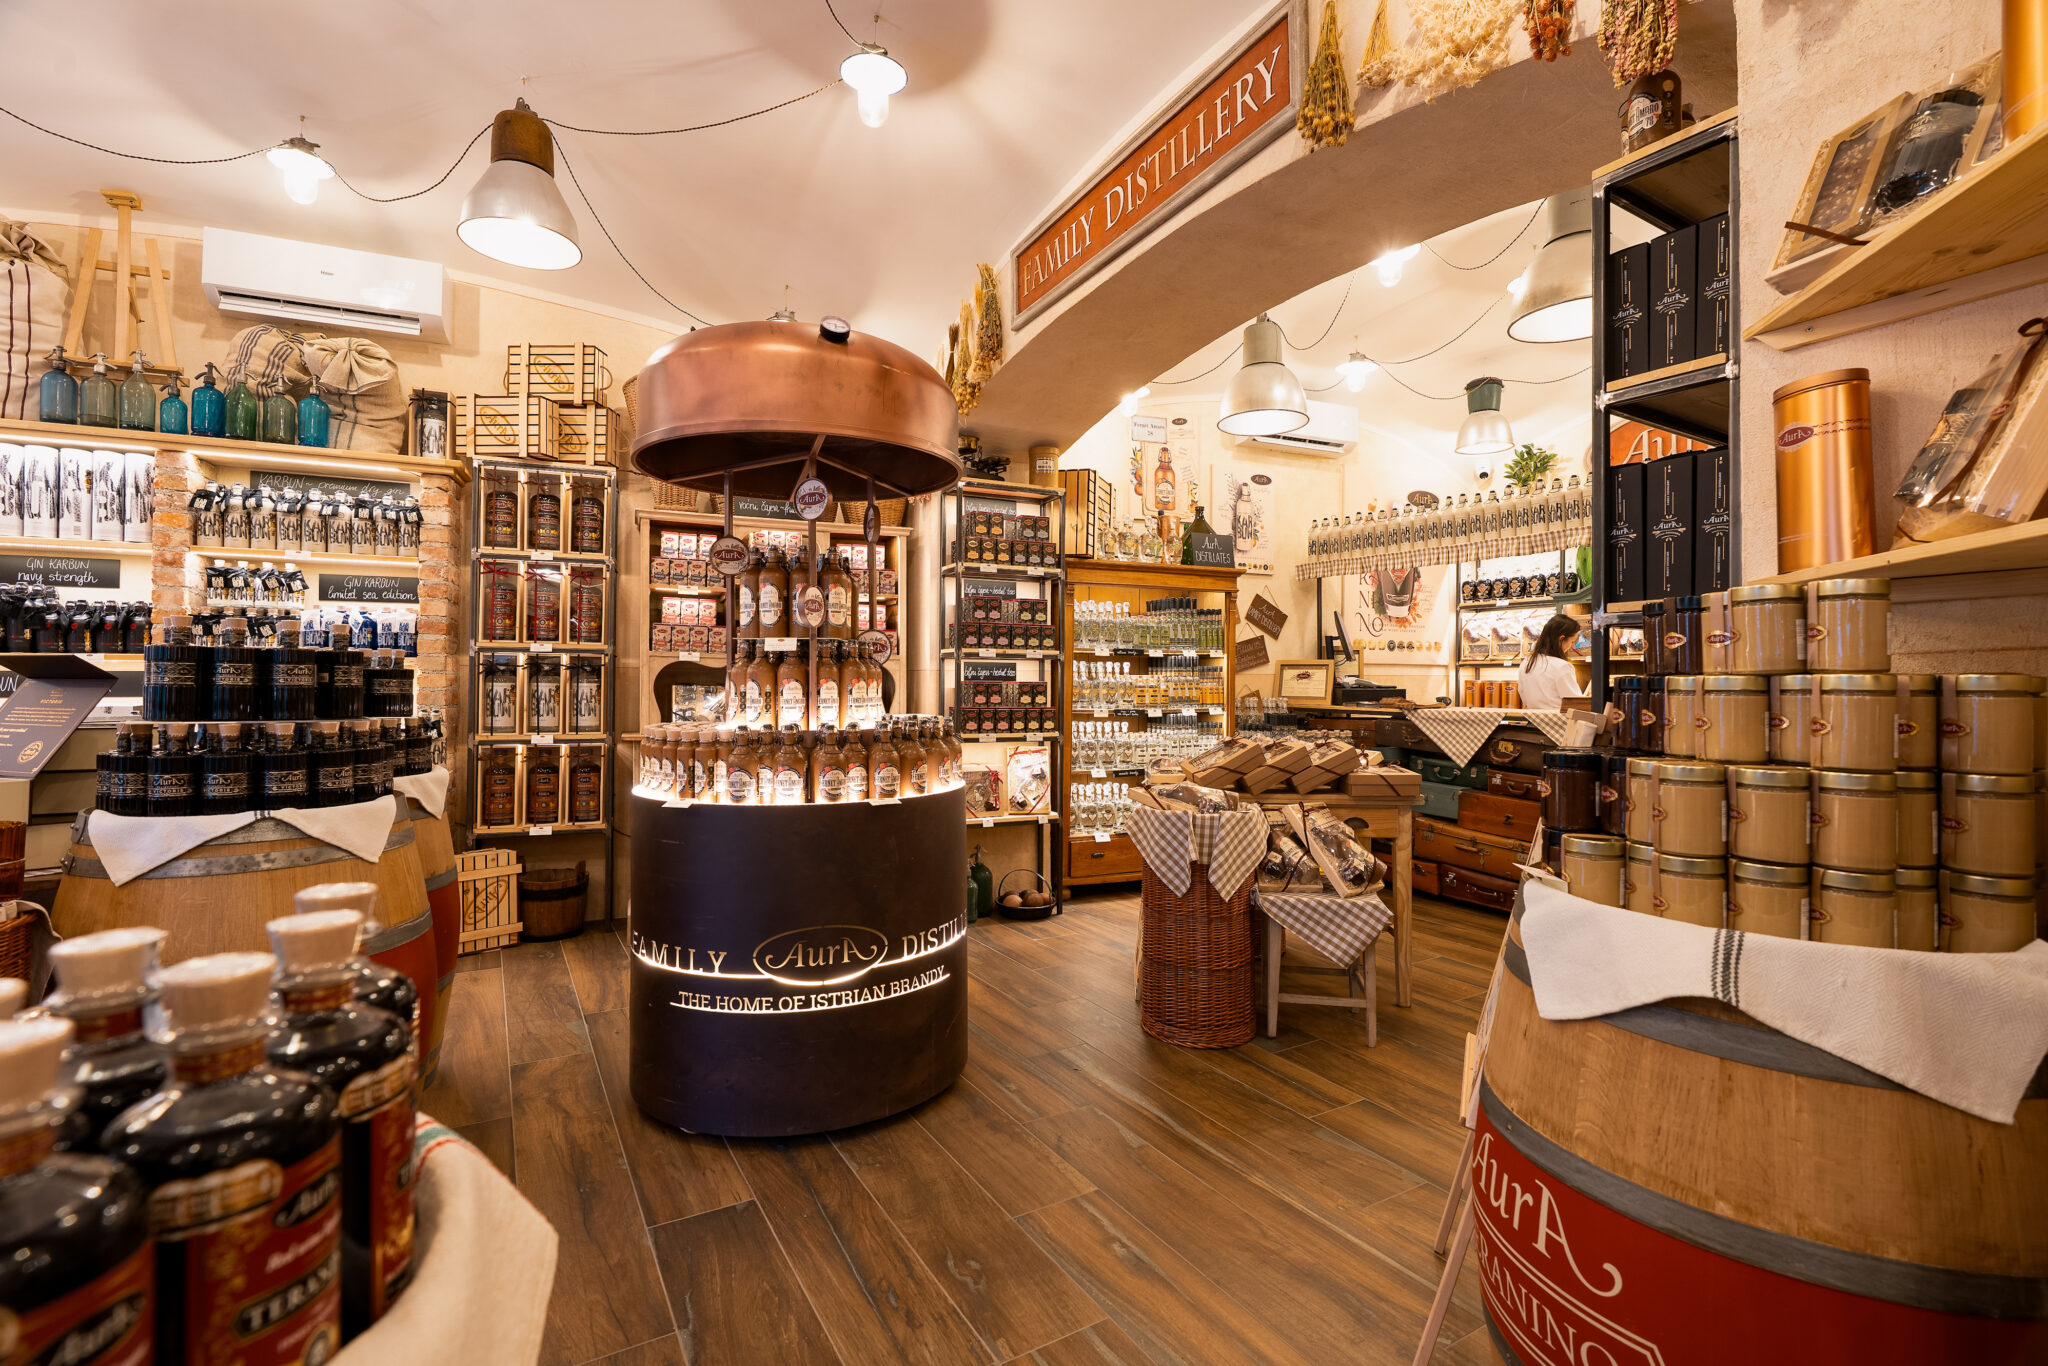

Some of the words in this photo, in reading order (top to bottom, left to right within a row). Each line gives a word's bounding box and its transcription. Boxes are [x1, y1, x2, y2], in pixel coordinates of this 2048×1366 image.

[1022, 205, 1096, 298] FAMILY
[1104, 44, 1282, 231] DISTILLERY
[1779, 430, 1812, 445] AurA
[258, 474, 306, 489] KARBUN
[1653, 521, 1682, 531] AurA
[714, 551, 745, 560] AurA
[26, 557, 44, 571] GIN
[49, 558, 90, 569] KARBUN
[17, 571, 43, 584] navy
[48, 570, 98, 586] strength
[343, 576, 362, 589] GIN
[364, 577, 399, 588] KARBUN
[327, 586, 357, 599] limited
[362, 591, 377, 599] sea
[382, 588, 418, 601] edition
[632, 930, 728, 975] FAMILY
[765, 937, 878, 968] AurA
[678, 991, 711, 1010] THE
[715, 994, 773, 1012] HOME
[779, 996, 805, 1011] OF
[810, 983, 885, 1009] ISTRIAN
[890, 965, 946, 997] BRANDY
[1473, 1133, 1623, 1297] AurA
[1478, 1230, 1619, 1366] RANINO
